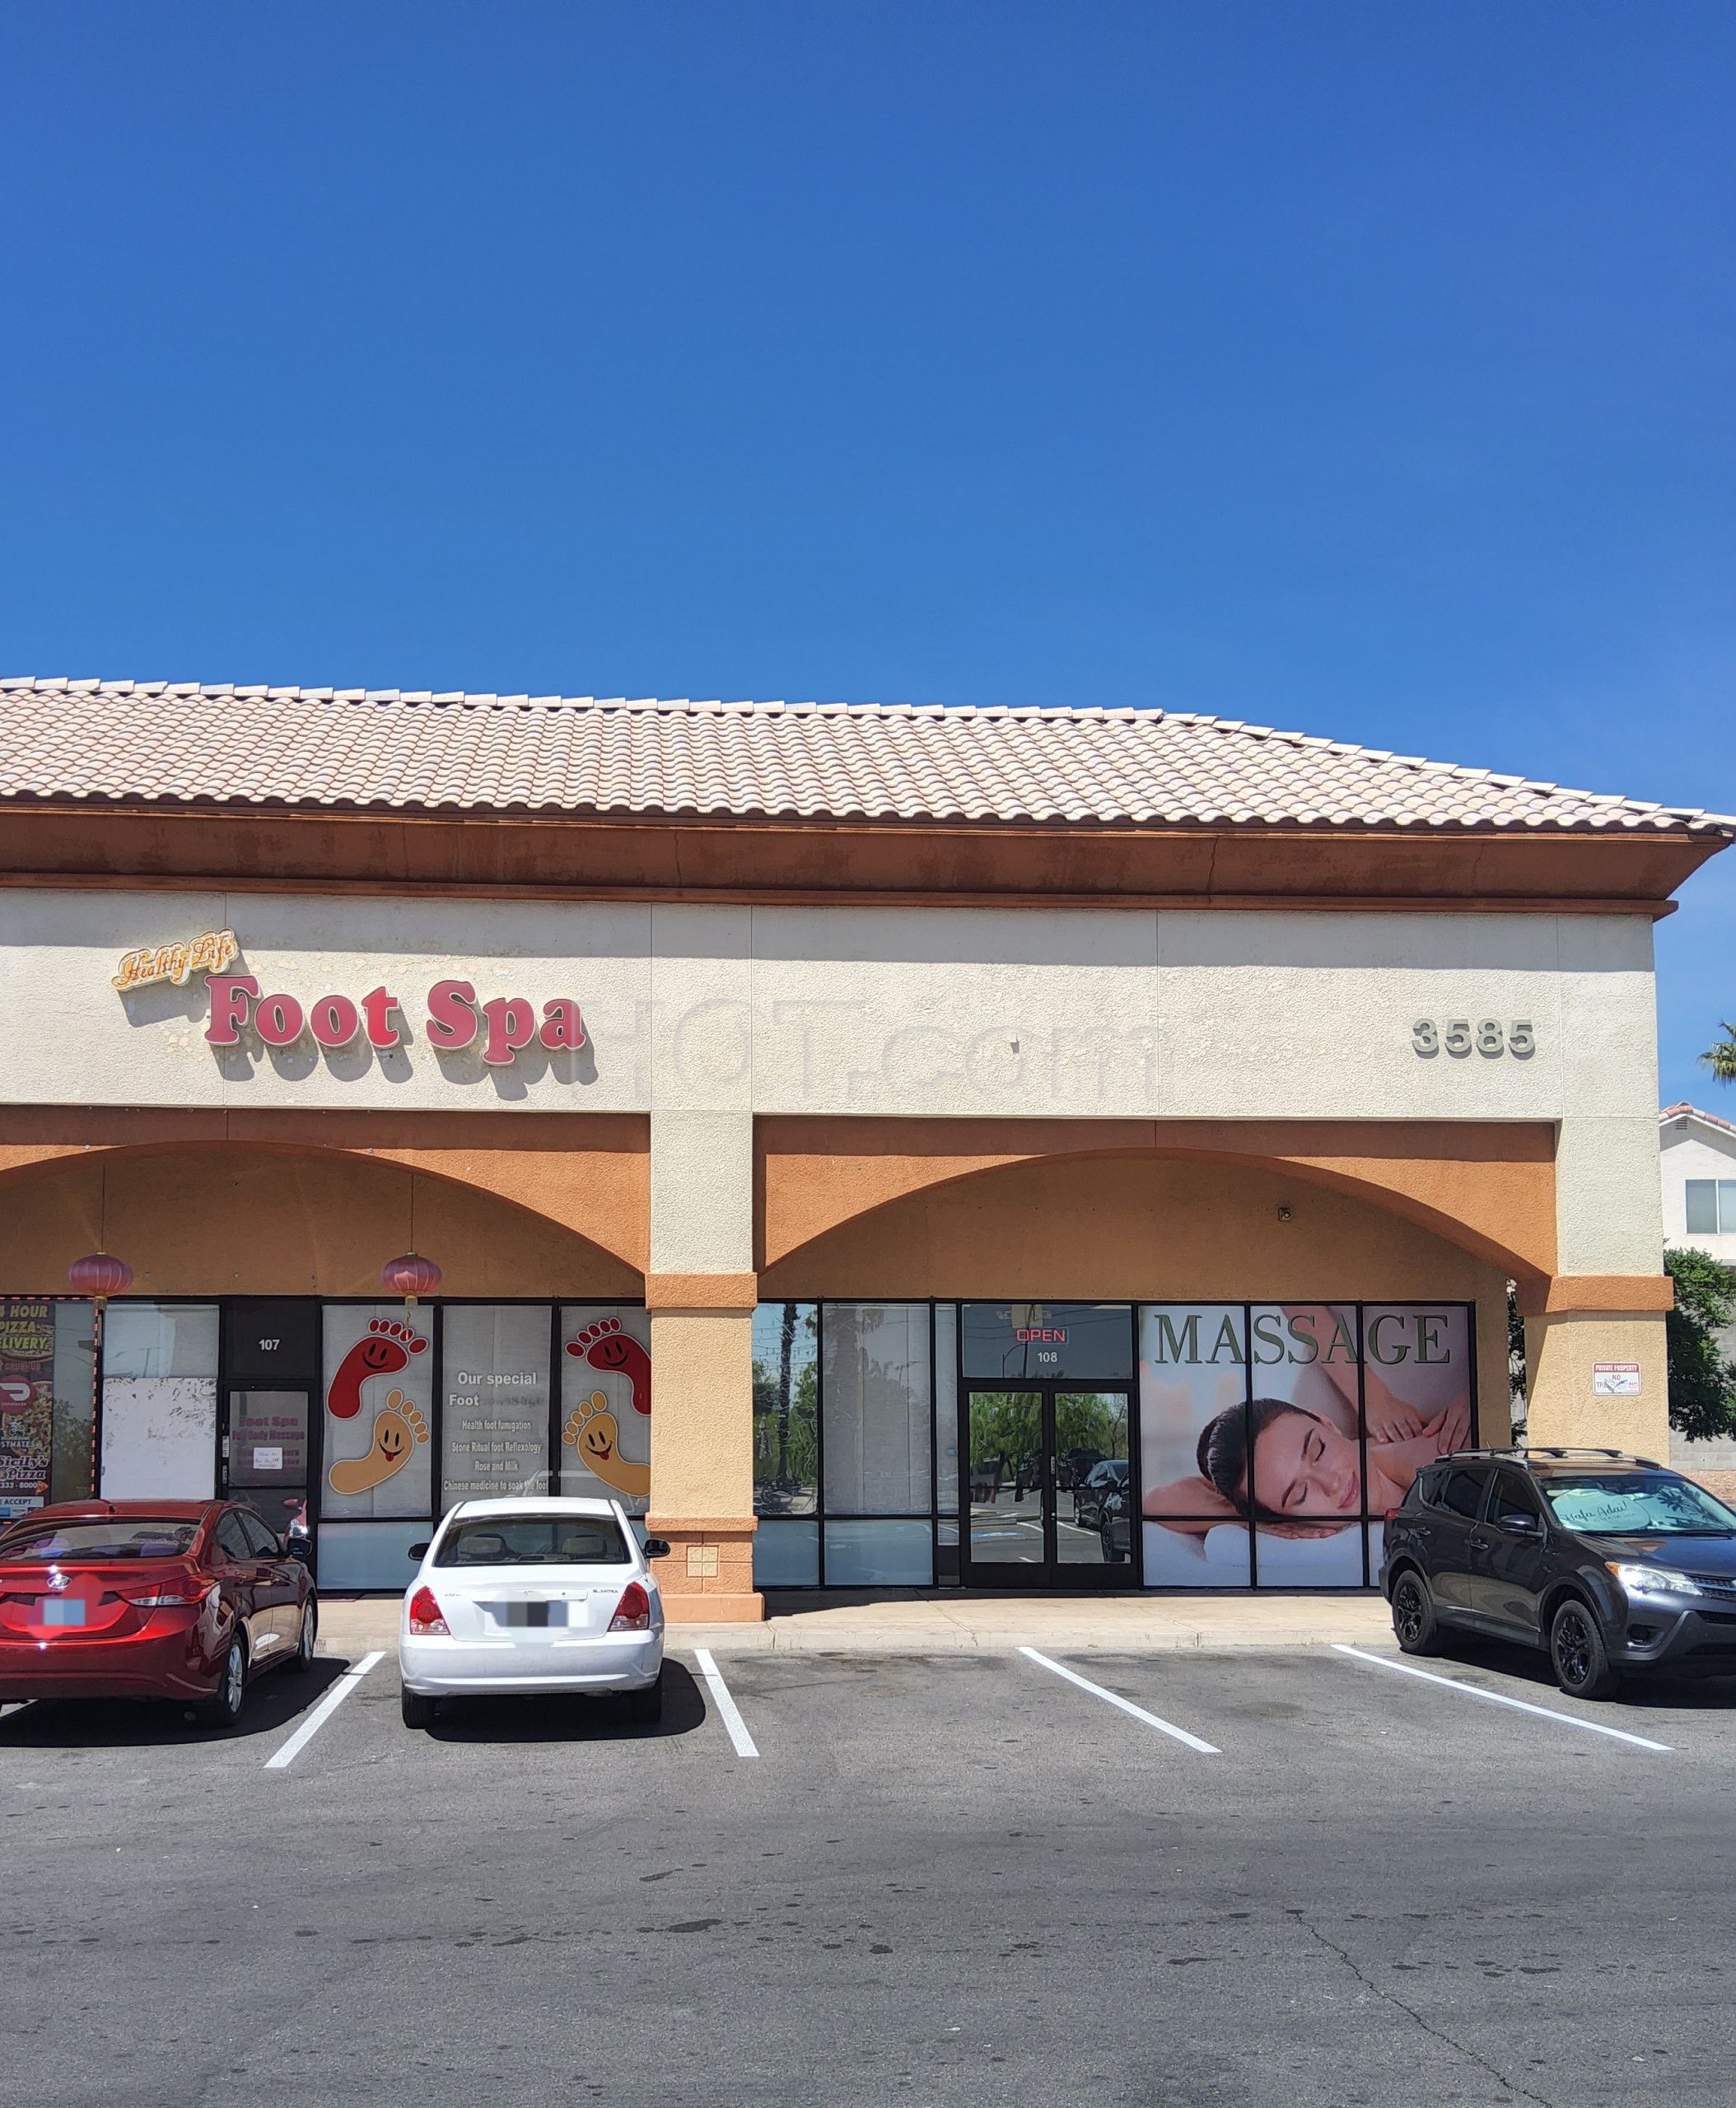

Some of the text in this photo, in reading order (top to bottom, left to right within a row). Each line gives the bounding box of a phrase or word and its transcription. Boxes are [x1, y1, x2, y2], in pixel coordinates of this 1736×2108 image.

[115, 934, 232, 986] Healthy Life
[204, 975, 586, 1067] Foot Spa
[1412, 1017, 1536, 1054] 3585
[10, 1304, 48, 1318] HOUR
[0, 1321, 36, 1333] PIZZA
[1016, 1329, 1066, 1342] OPEN
[1154, 1314, 1450, 1364] MASSAGE
[258, 1338, 281, 1350] 107
[1037, 1351, 1058, 1363] 108
[457, 1371, 537, 1388] Our special
[449, 1394, 479, 1406] Foot
[462, 1420, 483, 1430] Health
[484, 1420, 497, 1430] foot
[492, 1442, 504, 1452] foot
[474, 1461, 491, 1471] Rose
[491, 1461, 504, 1471] and
[6, 1467, 46, 1480] Pizza
[444, 1481, 469, 1490] Chinese
[469, 1480, 499, 1490] medicine
[500, 1480, 506, 1490] to
[508, 1480, 524, 1490] soak
